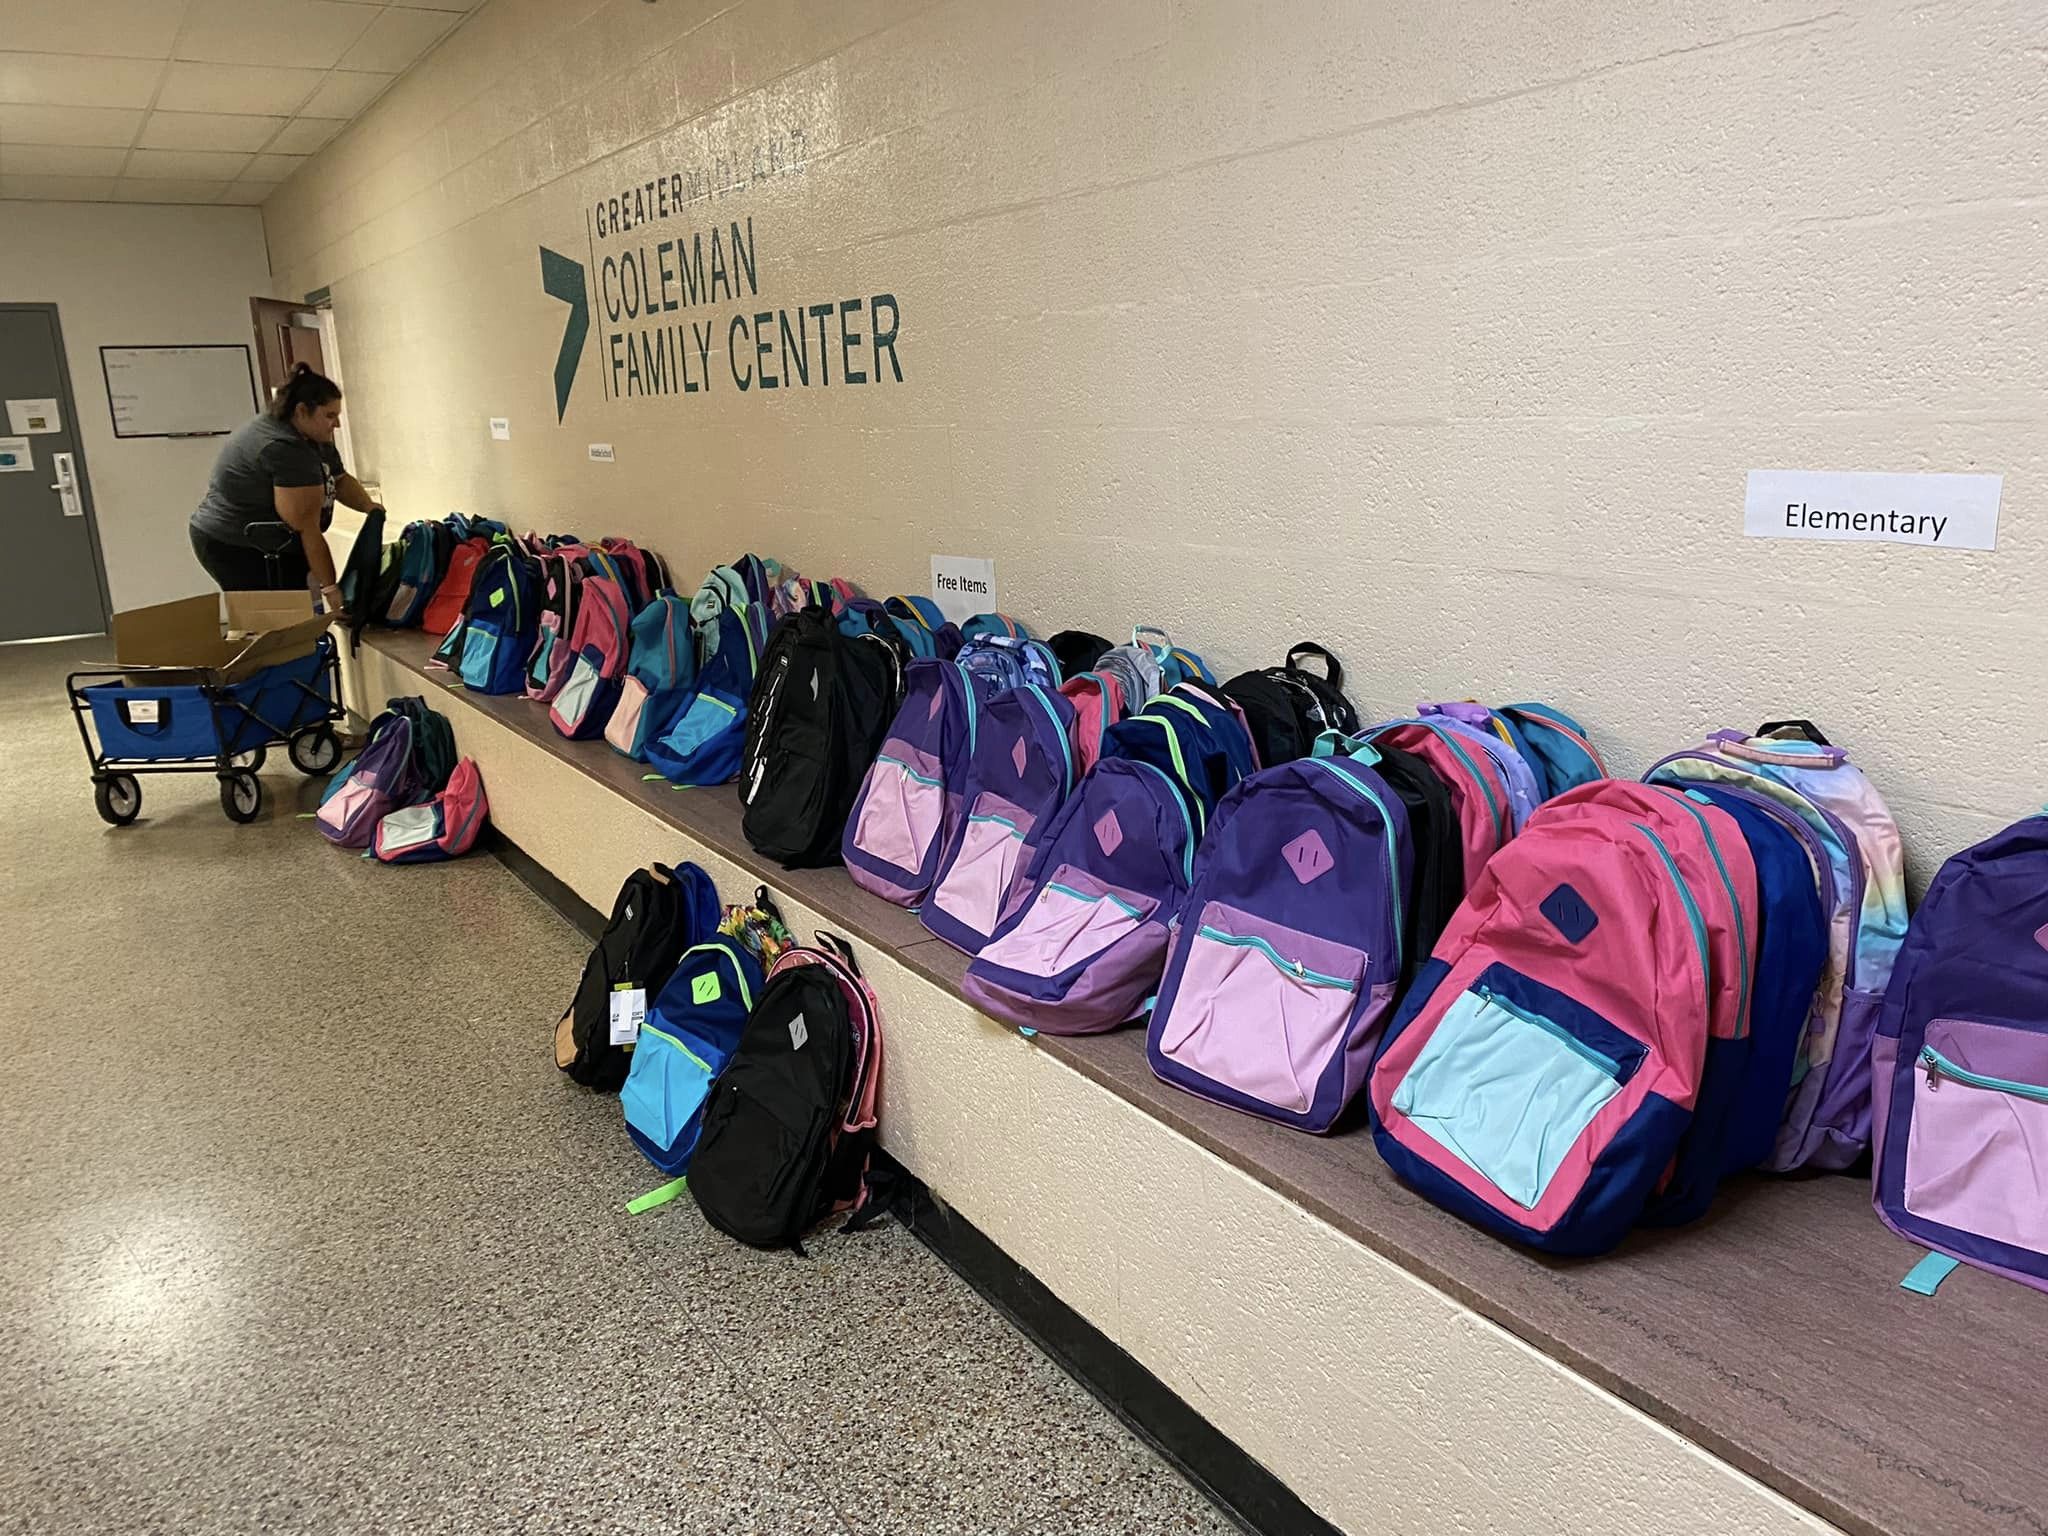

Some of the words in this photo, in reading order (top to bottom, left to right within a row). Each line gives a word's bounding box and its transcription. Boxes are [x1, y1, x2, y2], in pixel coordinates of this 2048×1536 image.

[596, 173, 683, 238] GREATER
[602, 217, 757, 322] COLEMAN
[611, 320, 712, 398] FAMILY
[729, 294, 903, 392] CENTER
[1786, 503, 1947, 541] Elementary
[937, 573, 957, 590] Free
[960, 576, 987, 594] Items
